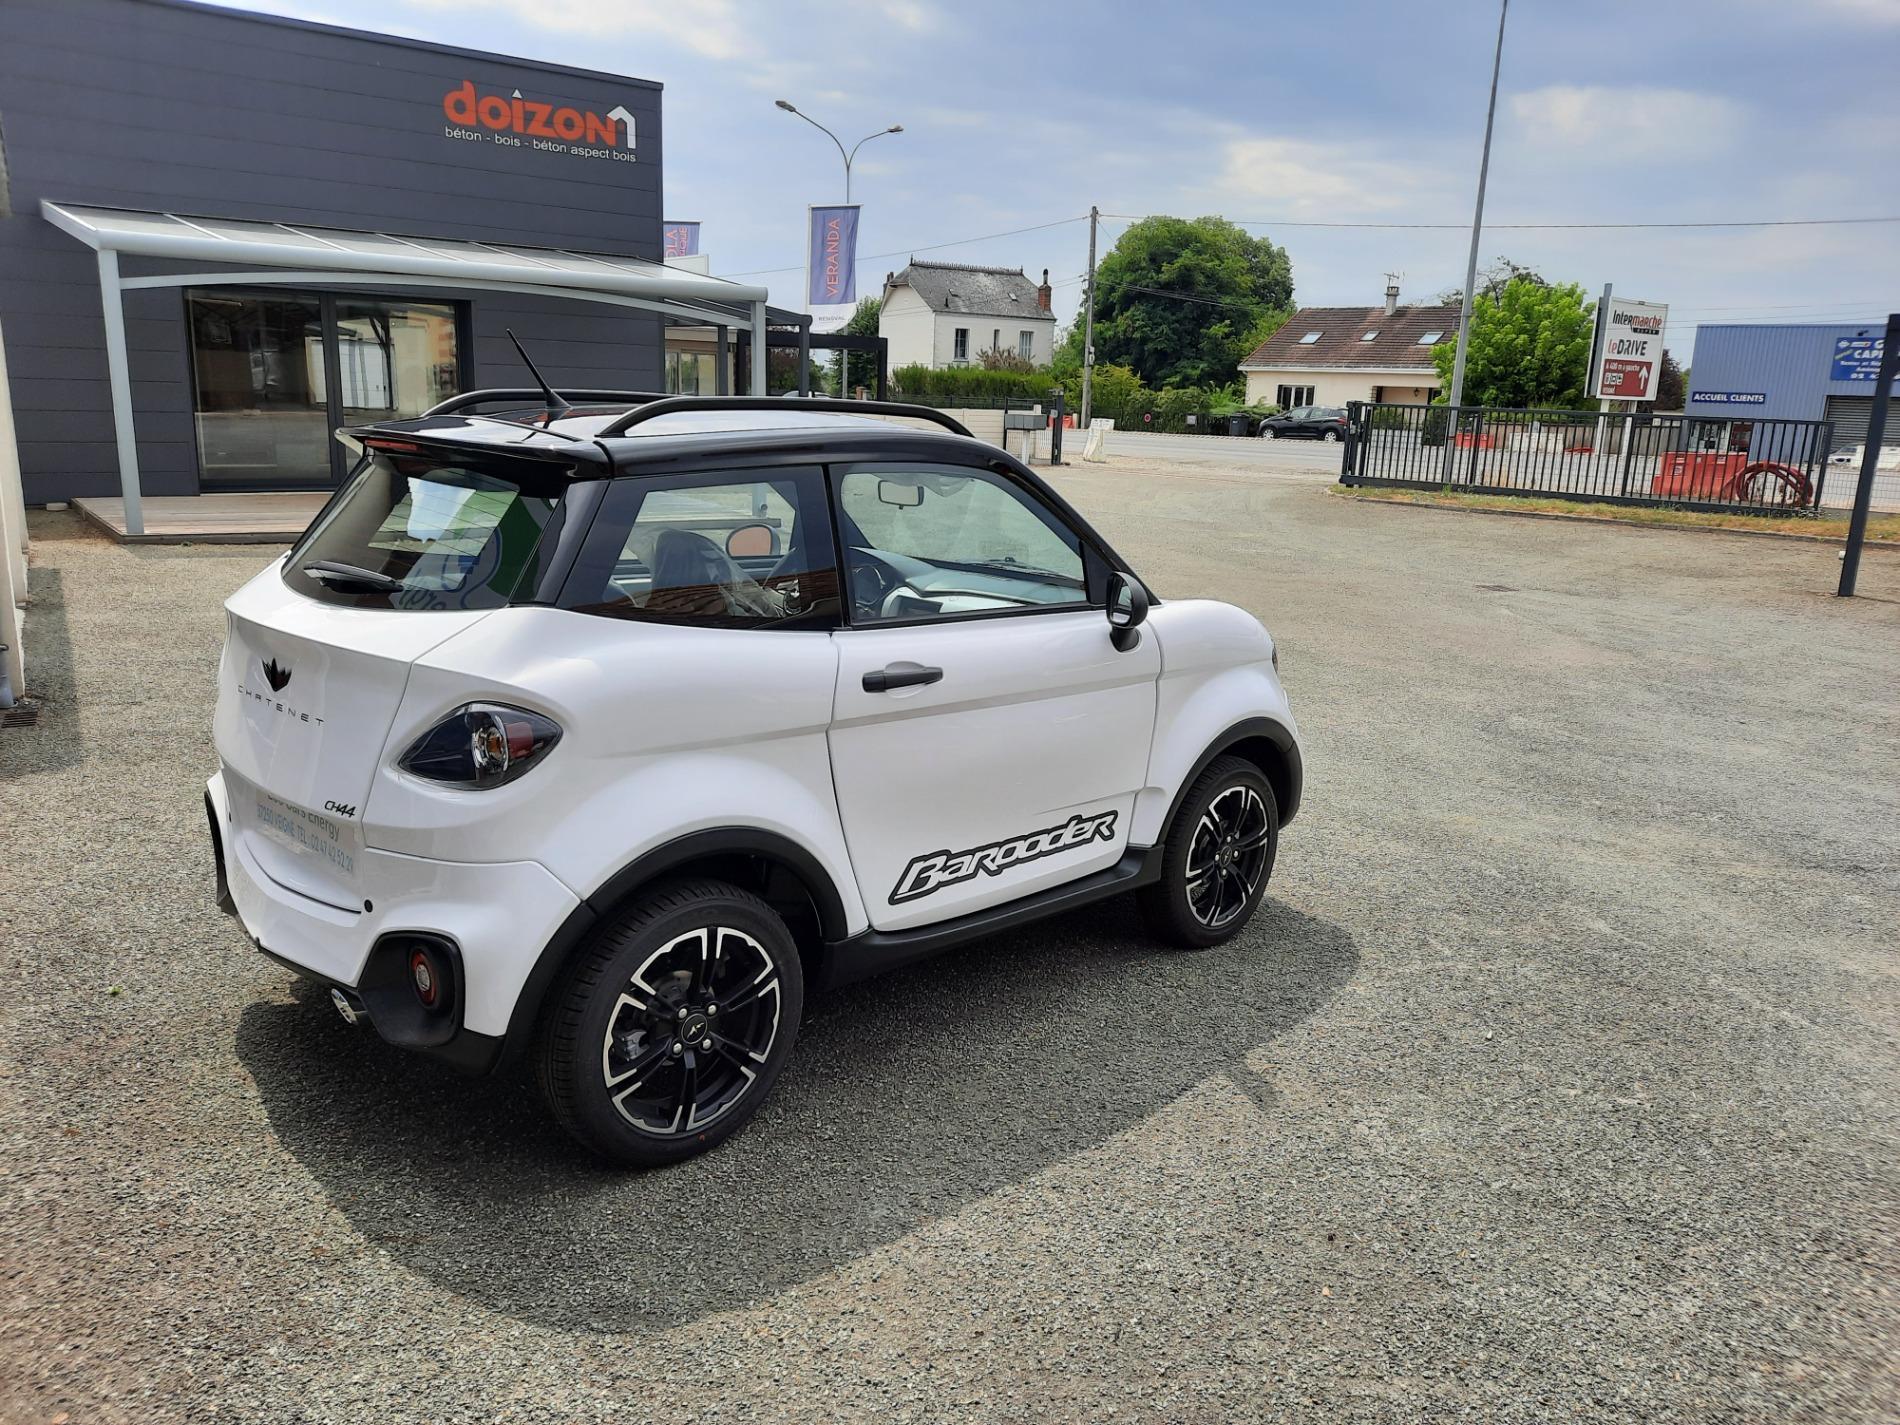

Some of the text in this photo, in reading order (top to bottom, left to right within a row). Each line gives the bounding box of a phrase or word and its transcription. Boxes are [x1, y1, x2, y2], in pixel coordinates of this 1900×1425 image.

[443, 79, 616, 147] doizon
[445, 126, 482, 142] béton
[494, 132, 521, 147] bois
[533, 139, 567, 154] béton
[570, 145, 610, 160] aspect
[612, 150, 636, 163] bois
[824, 217, 840, 298] VERANDA
[1693, 393, 1764, 403] ACCUEIL CLIENTS
[237, 684, 324, 726] CHATENET
[324, 800, 356, 818] CH44
